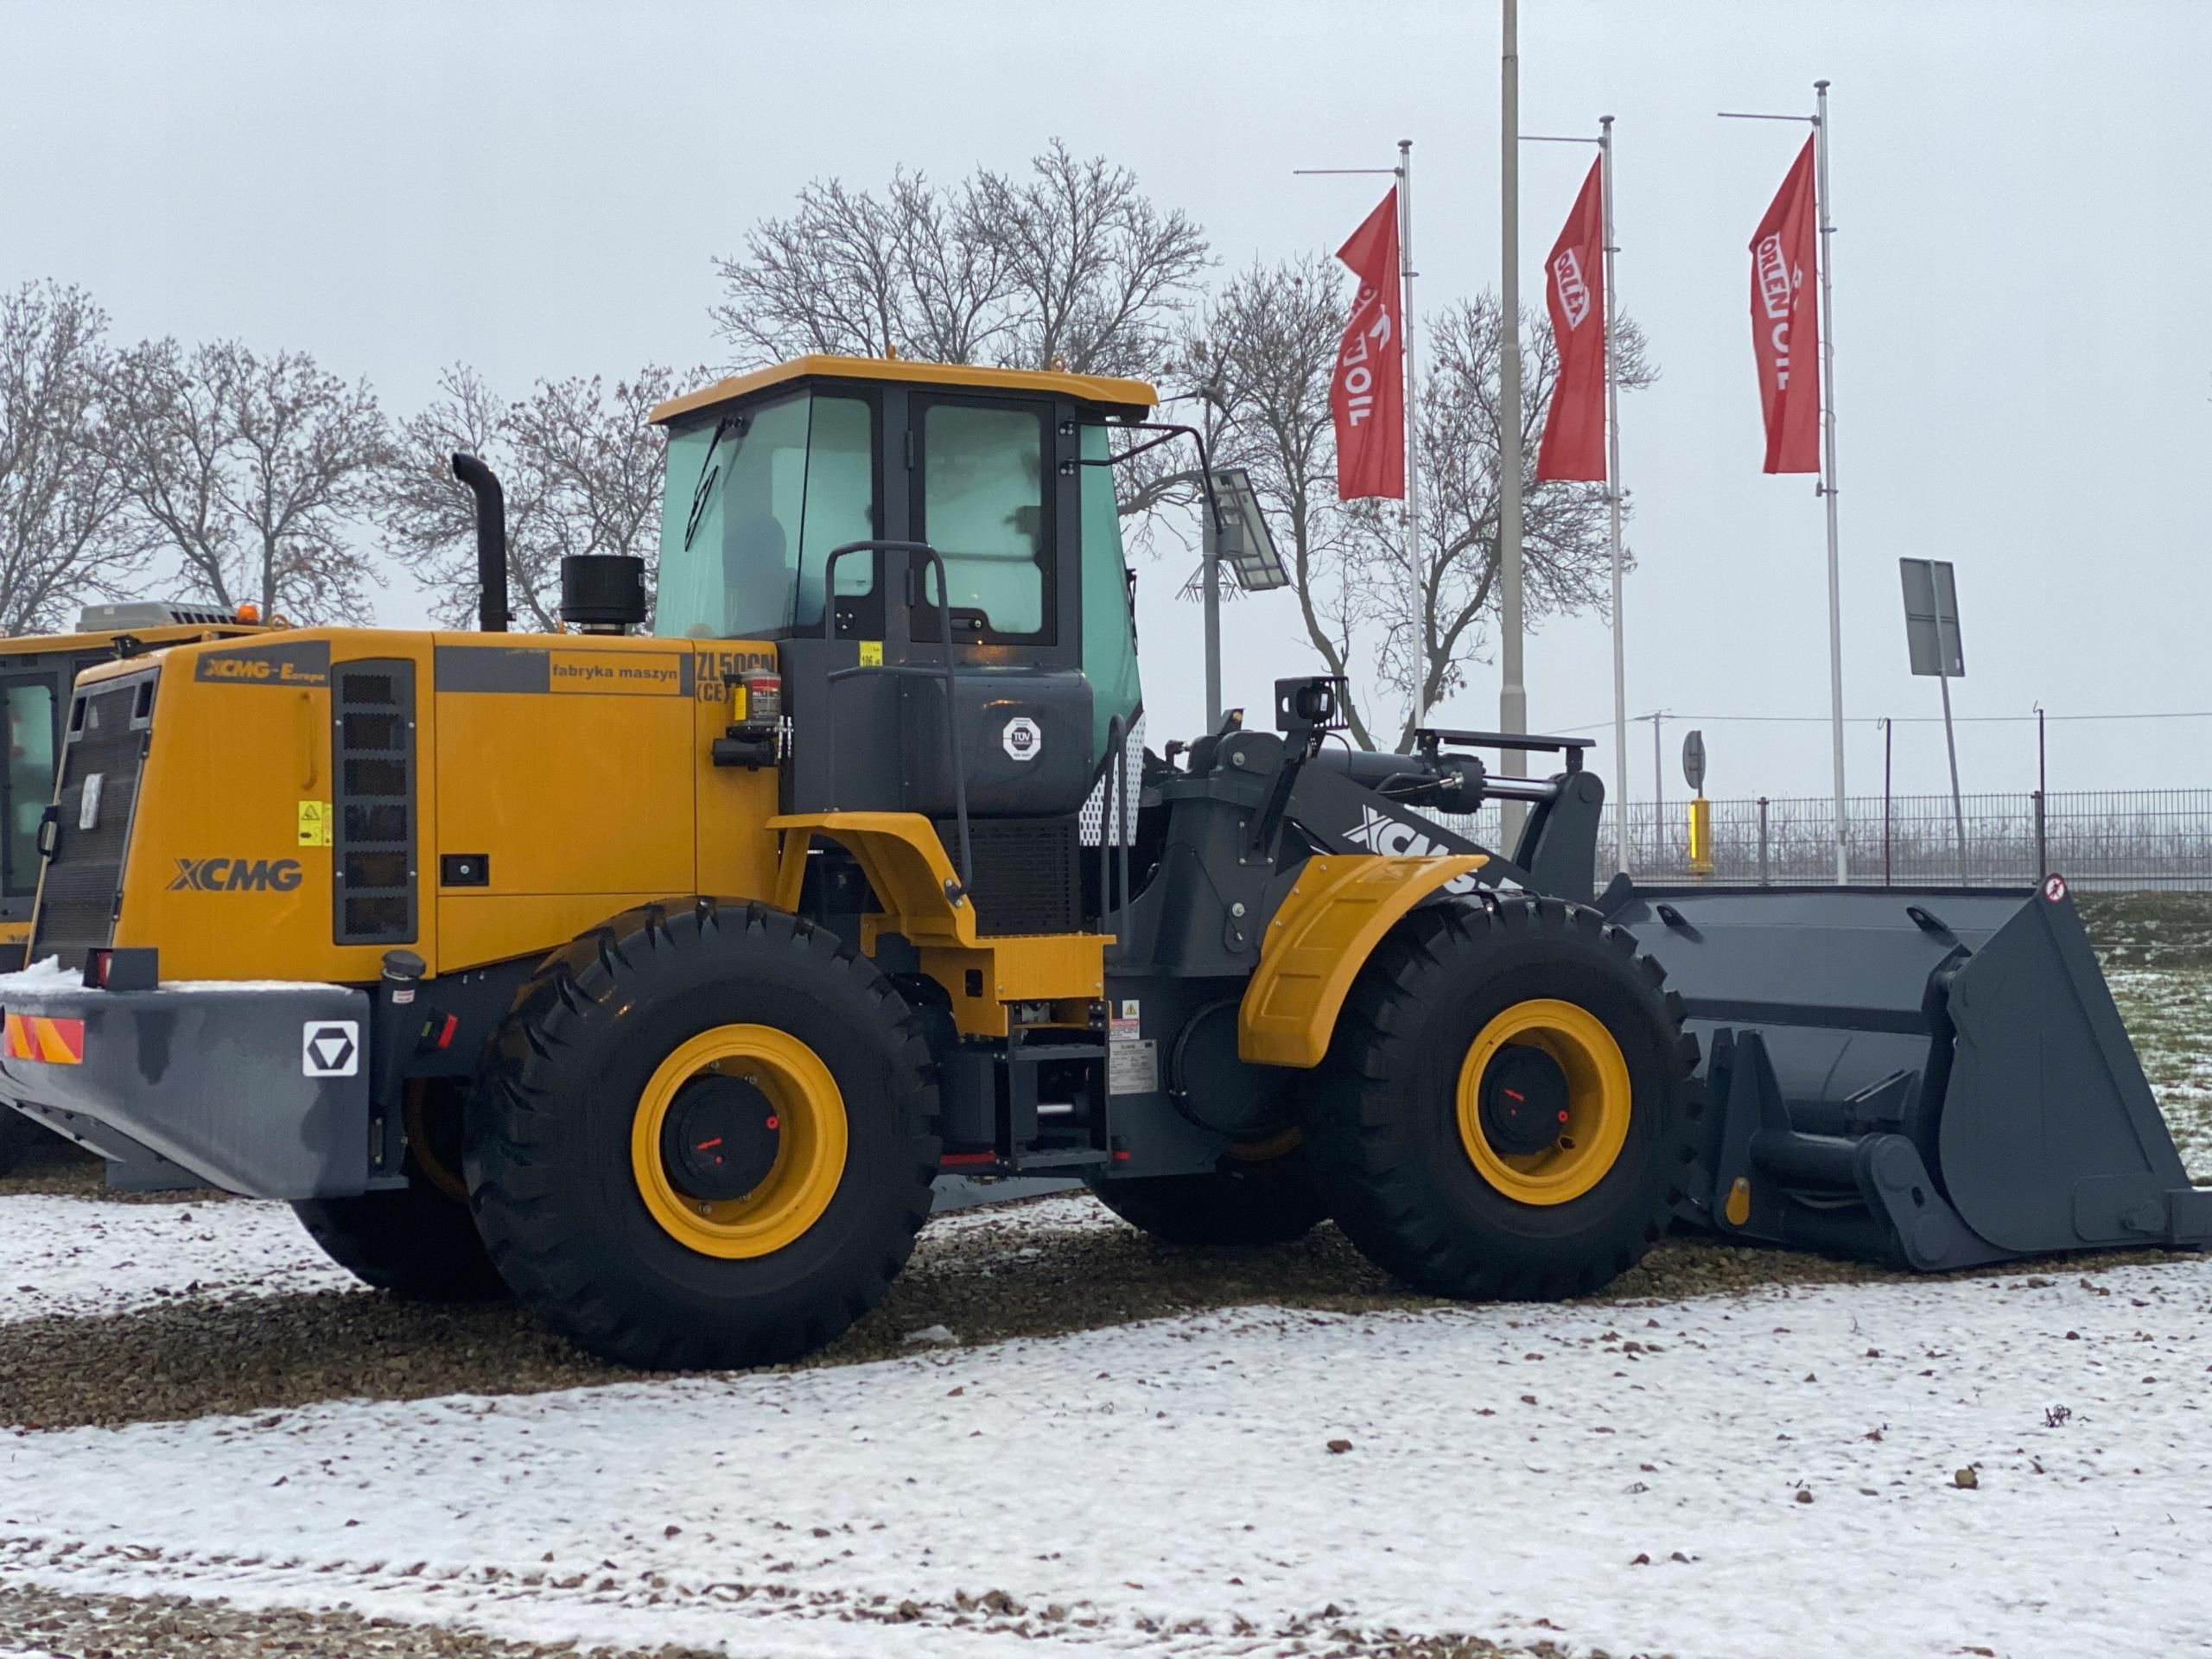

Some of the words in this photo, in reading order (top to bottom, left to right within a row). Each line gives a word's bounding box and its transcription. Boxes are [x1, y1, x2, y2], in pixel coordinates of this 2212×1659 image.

[1759, 238, 1789, 312] ORLEN
[1344, 366, 1373, 426] OIL
[552, 664, 613, 679] fabryka
[619, 668, 677, 682] maszyn
[696, 683, 731, 704] (CE)
[164, 858, 303, 891] XCMG
